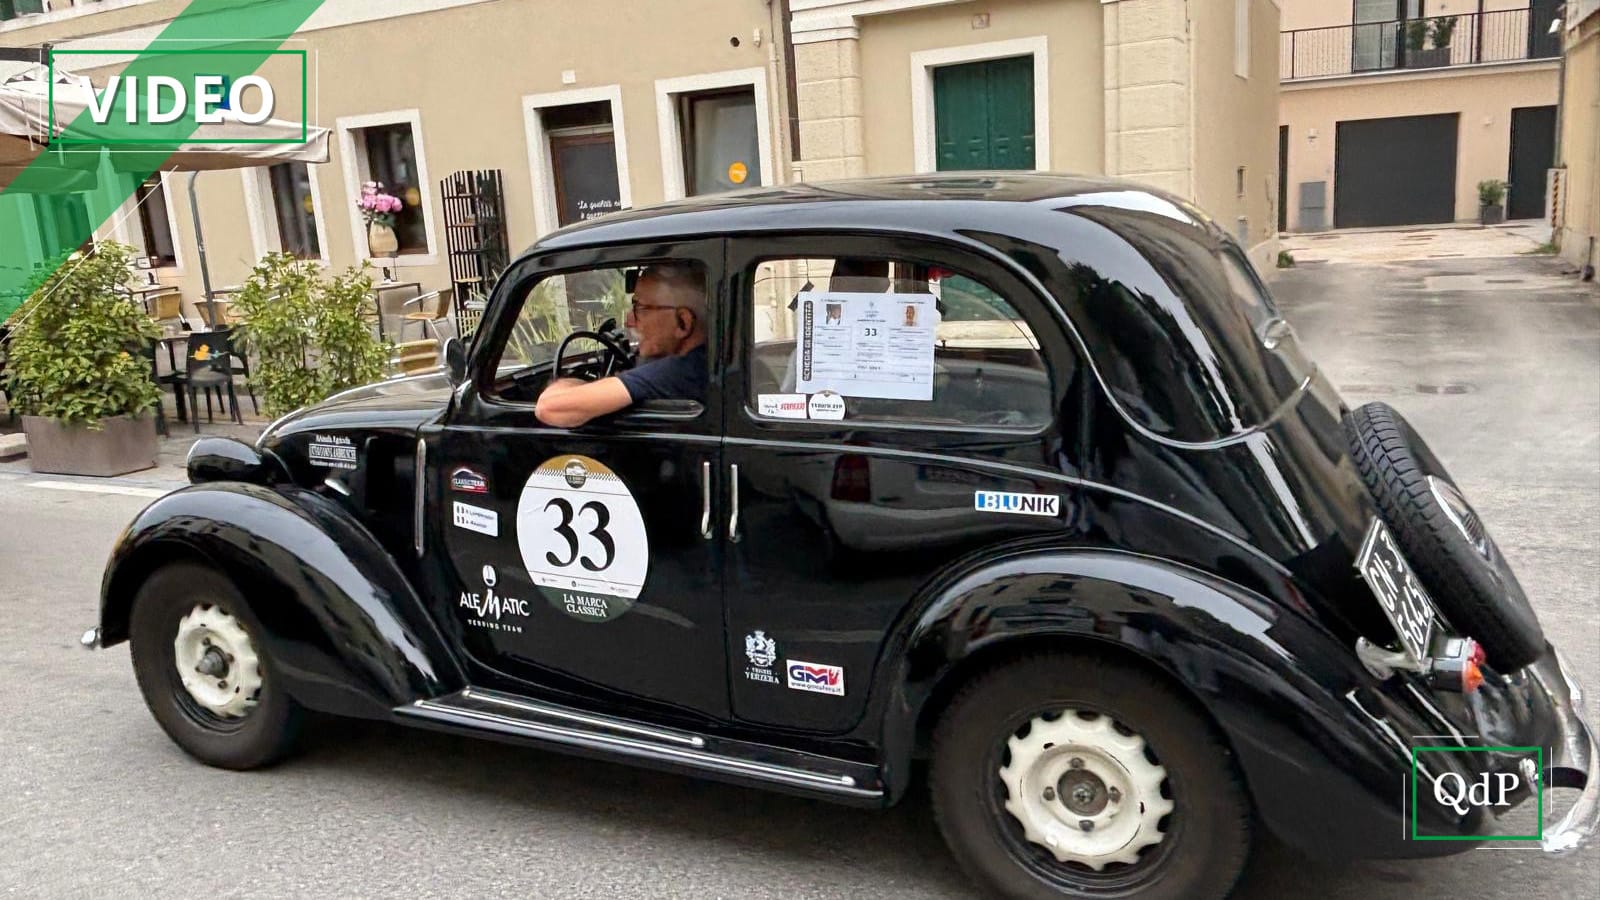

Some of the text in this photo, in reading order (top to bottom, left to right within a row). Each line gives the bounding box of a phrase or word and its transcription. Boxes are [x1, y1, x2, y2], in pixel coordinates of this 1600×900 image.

[864, 328, 877, 337] 33
[978, 493, 1055, 513] BLUNIK
[543, 497, 615, 572] 33
[563, 593, 608, 609] LA MARCA
[566, 603, 607, 618] CLASSICA
[1397, 574, 1430, 661] 5645
